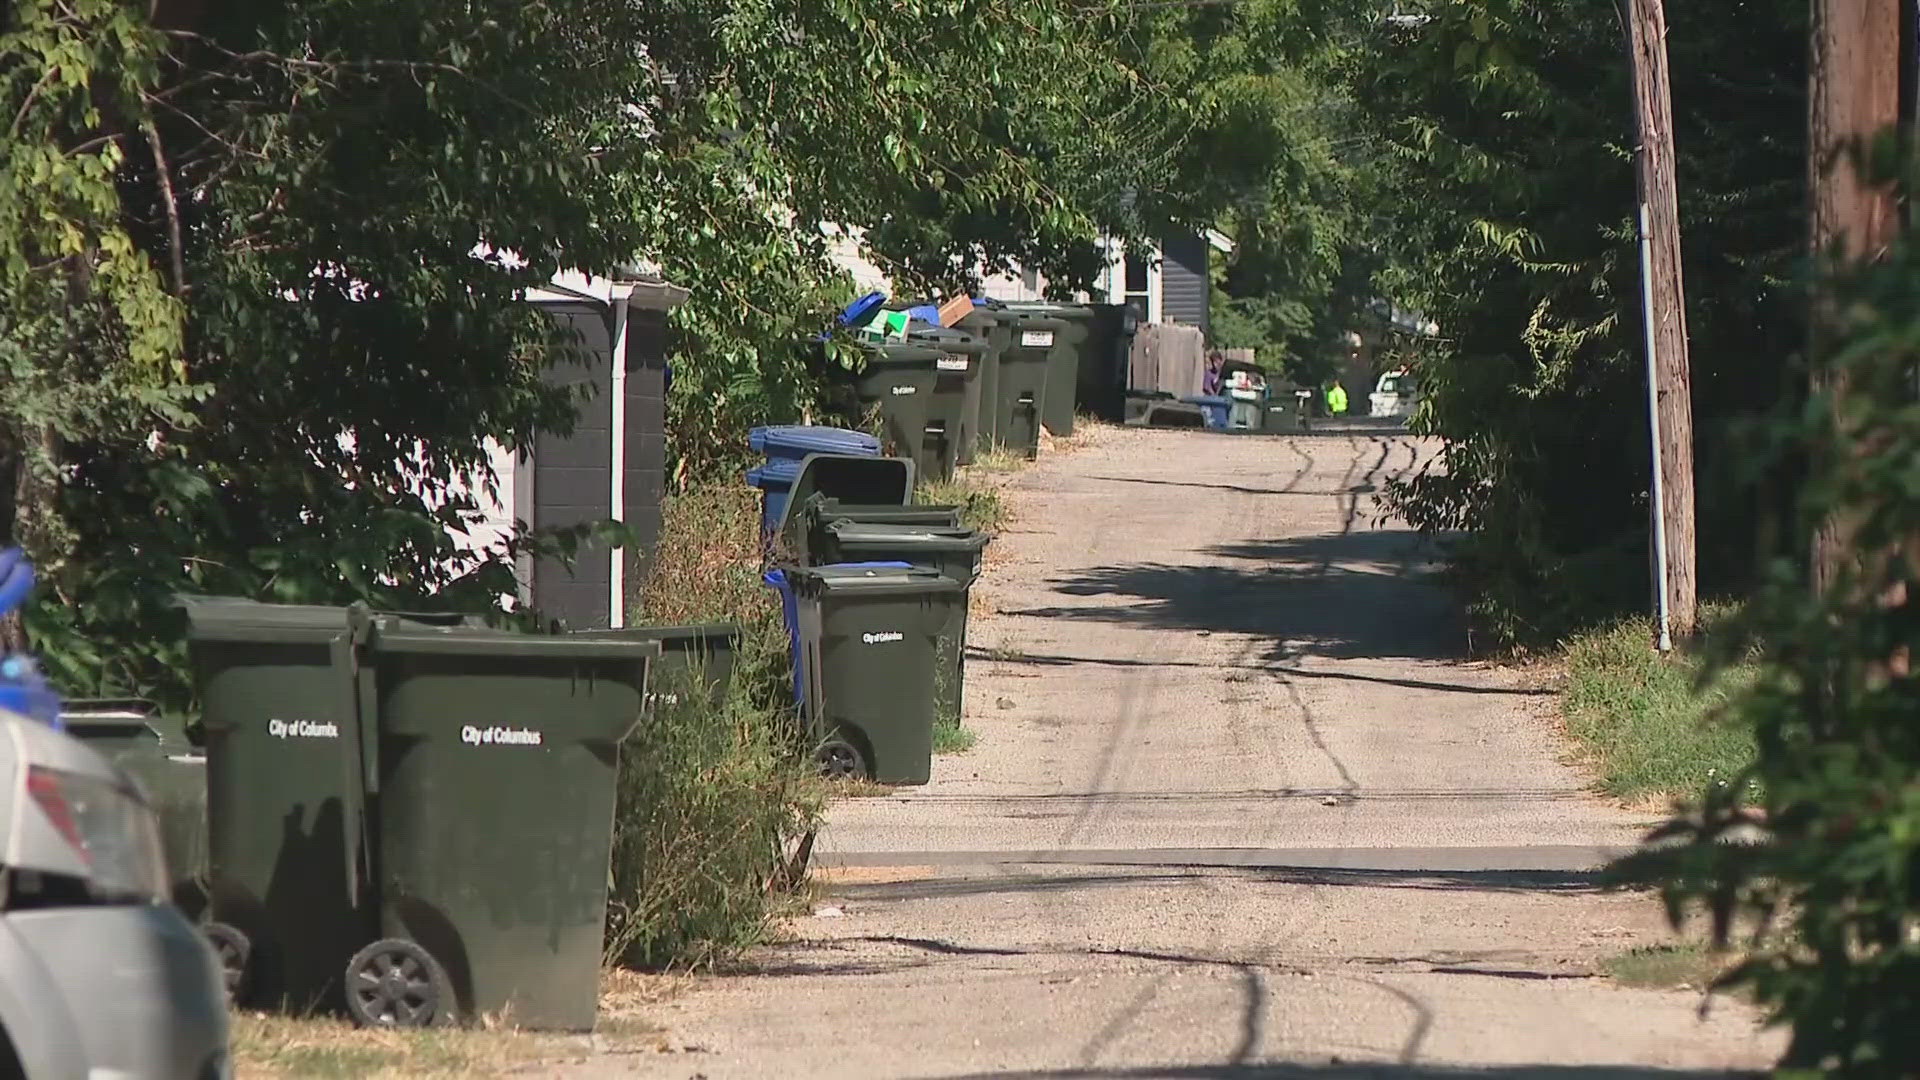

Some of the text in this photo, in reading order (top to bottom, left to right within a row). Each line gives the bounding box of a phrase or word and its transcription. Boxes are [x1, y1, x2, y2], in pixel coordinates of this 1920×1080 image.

[269, 719, 288, 739] City
[288, 719, 299, 736] of
[461, 724, 542, 746] City of Columbus
